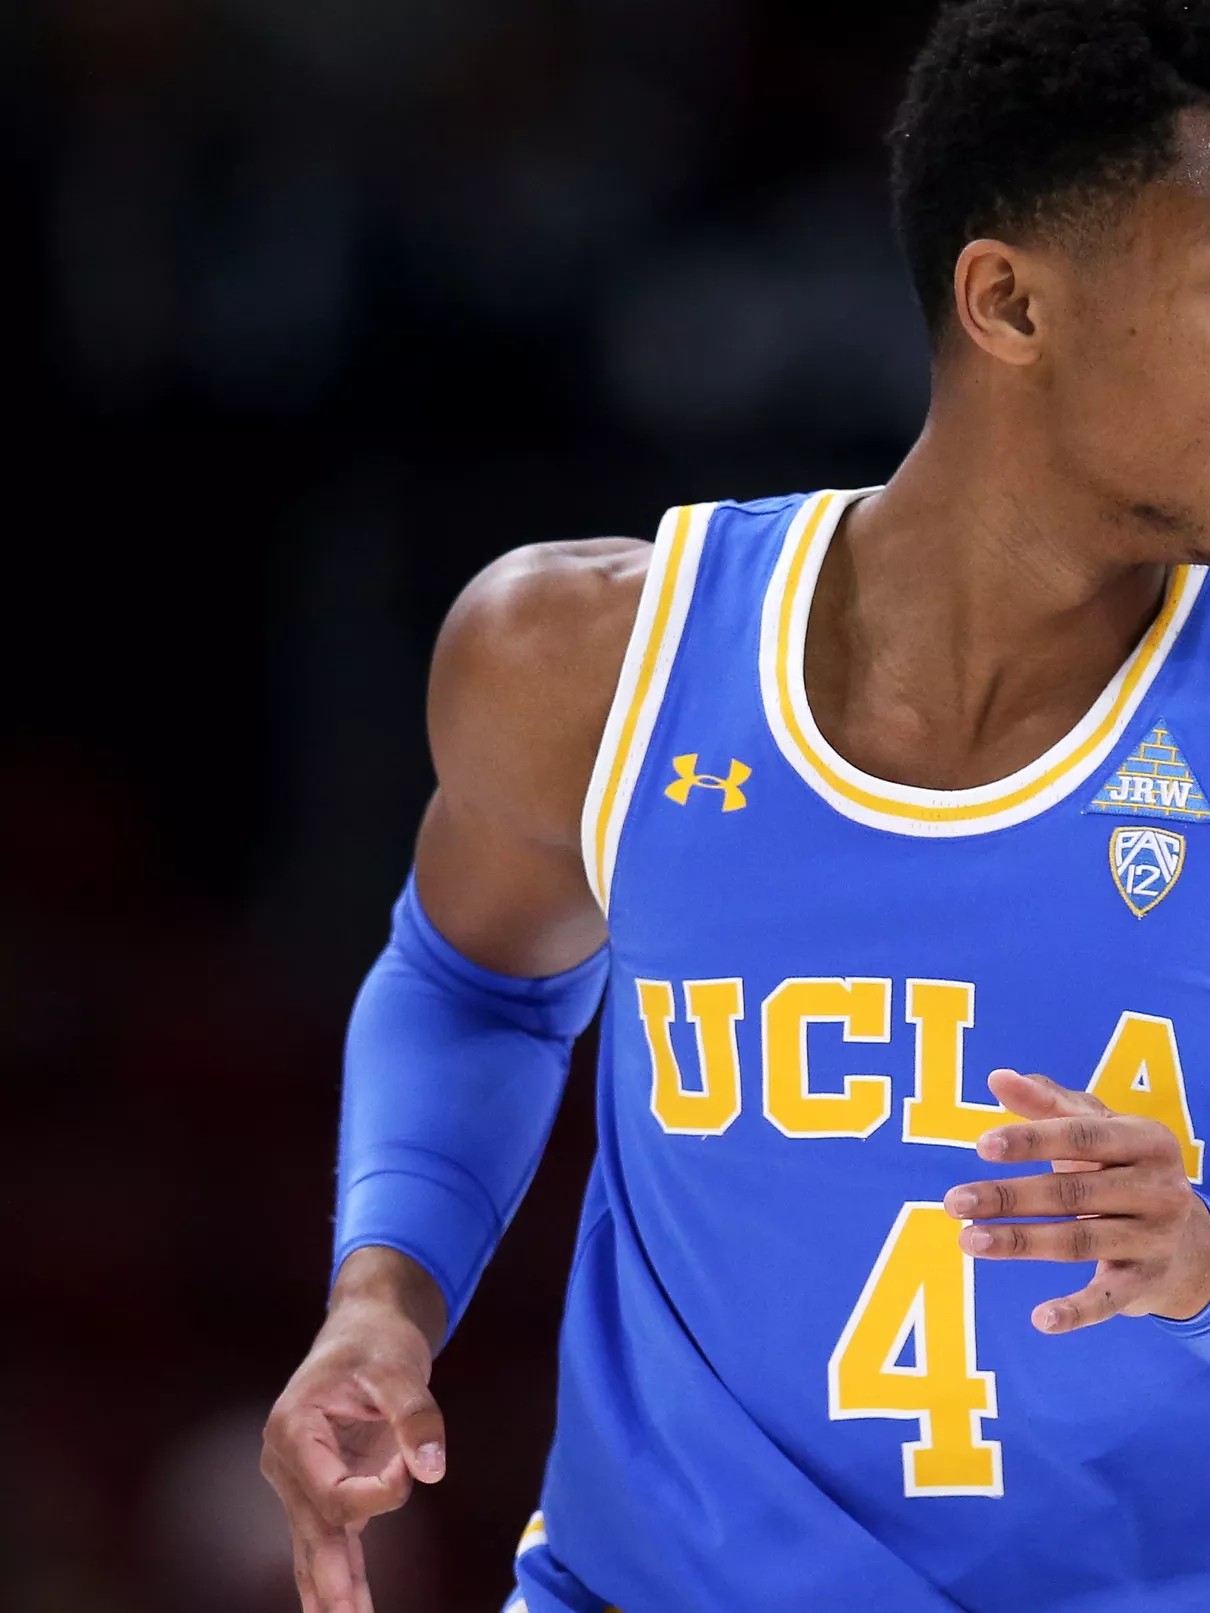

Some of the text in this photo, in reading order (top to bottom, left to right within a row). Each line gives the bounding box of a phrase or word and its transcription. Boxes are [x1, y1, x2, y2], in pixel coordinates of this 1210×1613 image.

[1109, 775, 1192, 808] JRW
[1115, 830, 1180, 884] PAC
[1126, 864, 1161, 896] 12
[634, 977, 1205, 1185] UCLA
[828, 1201, 1004, 1498] 4
